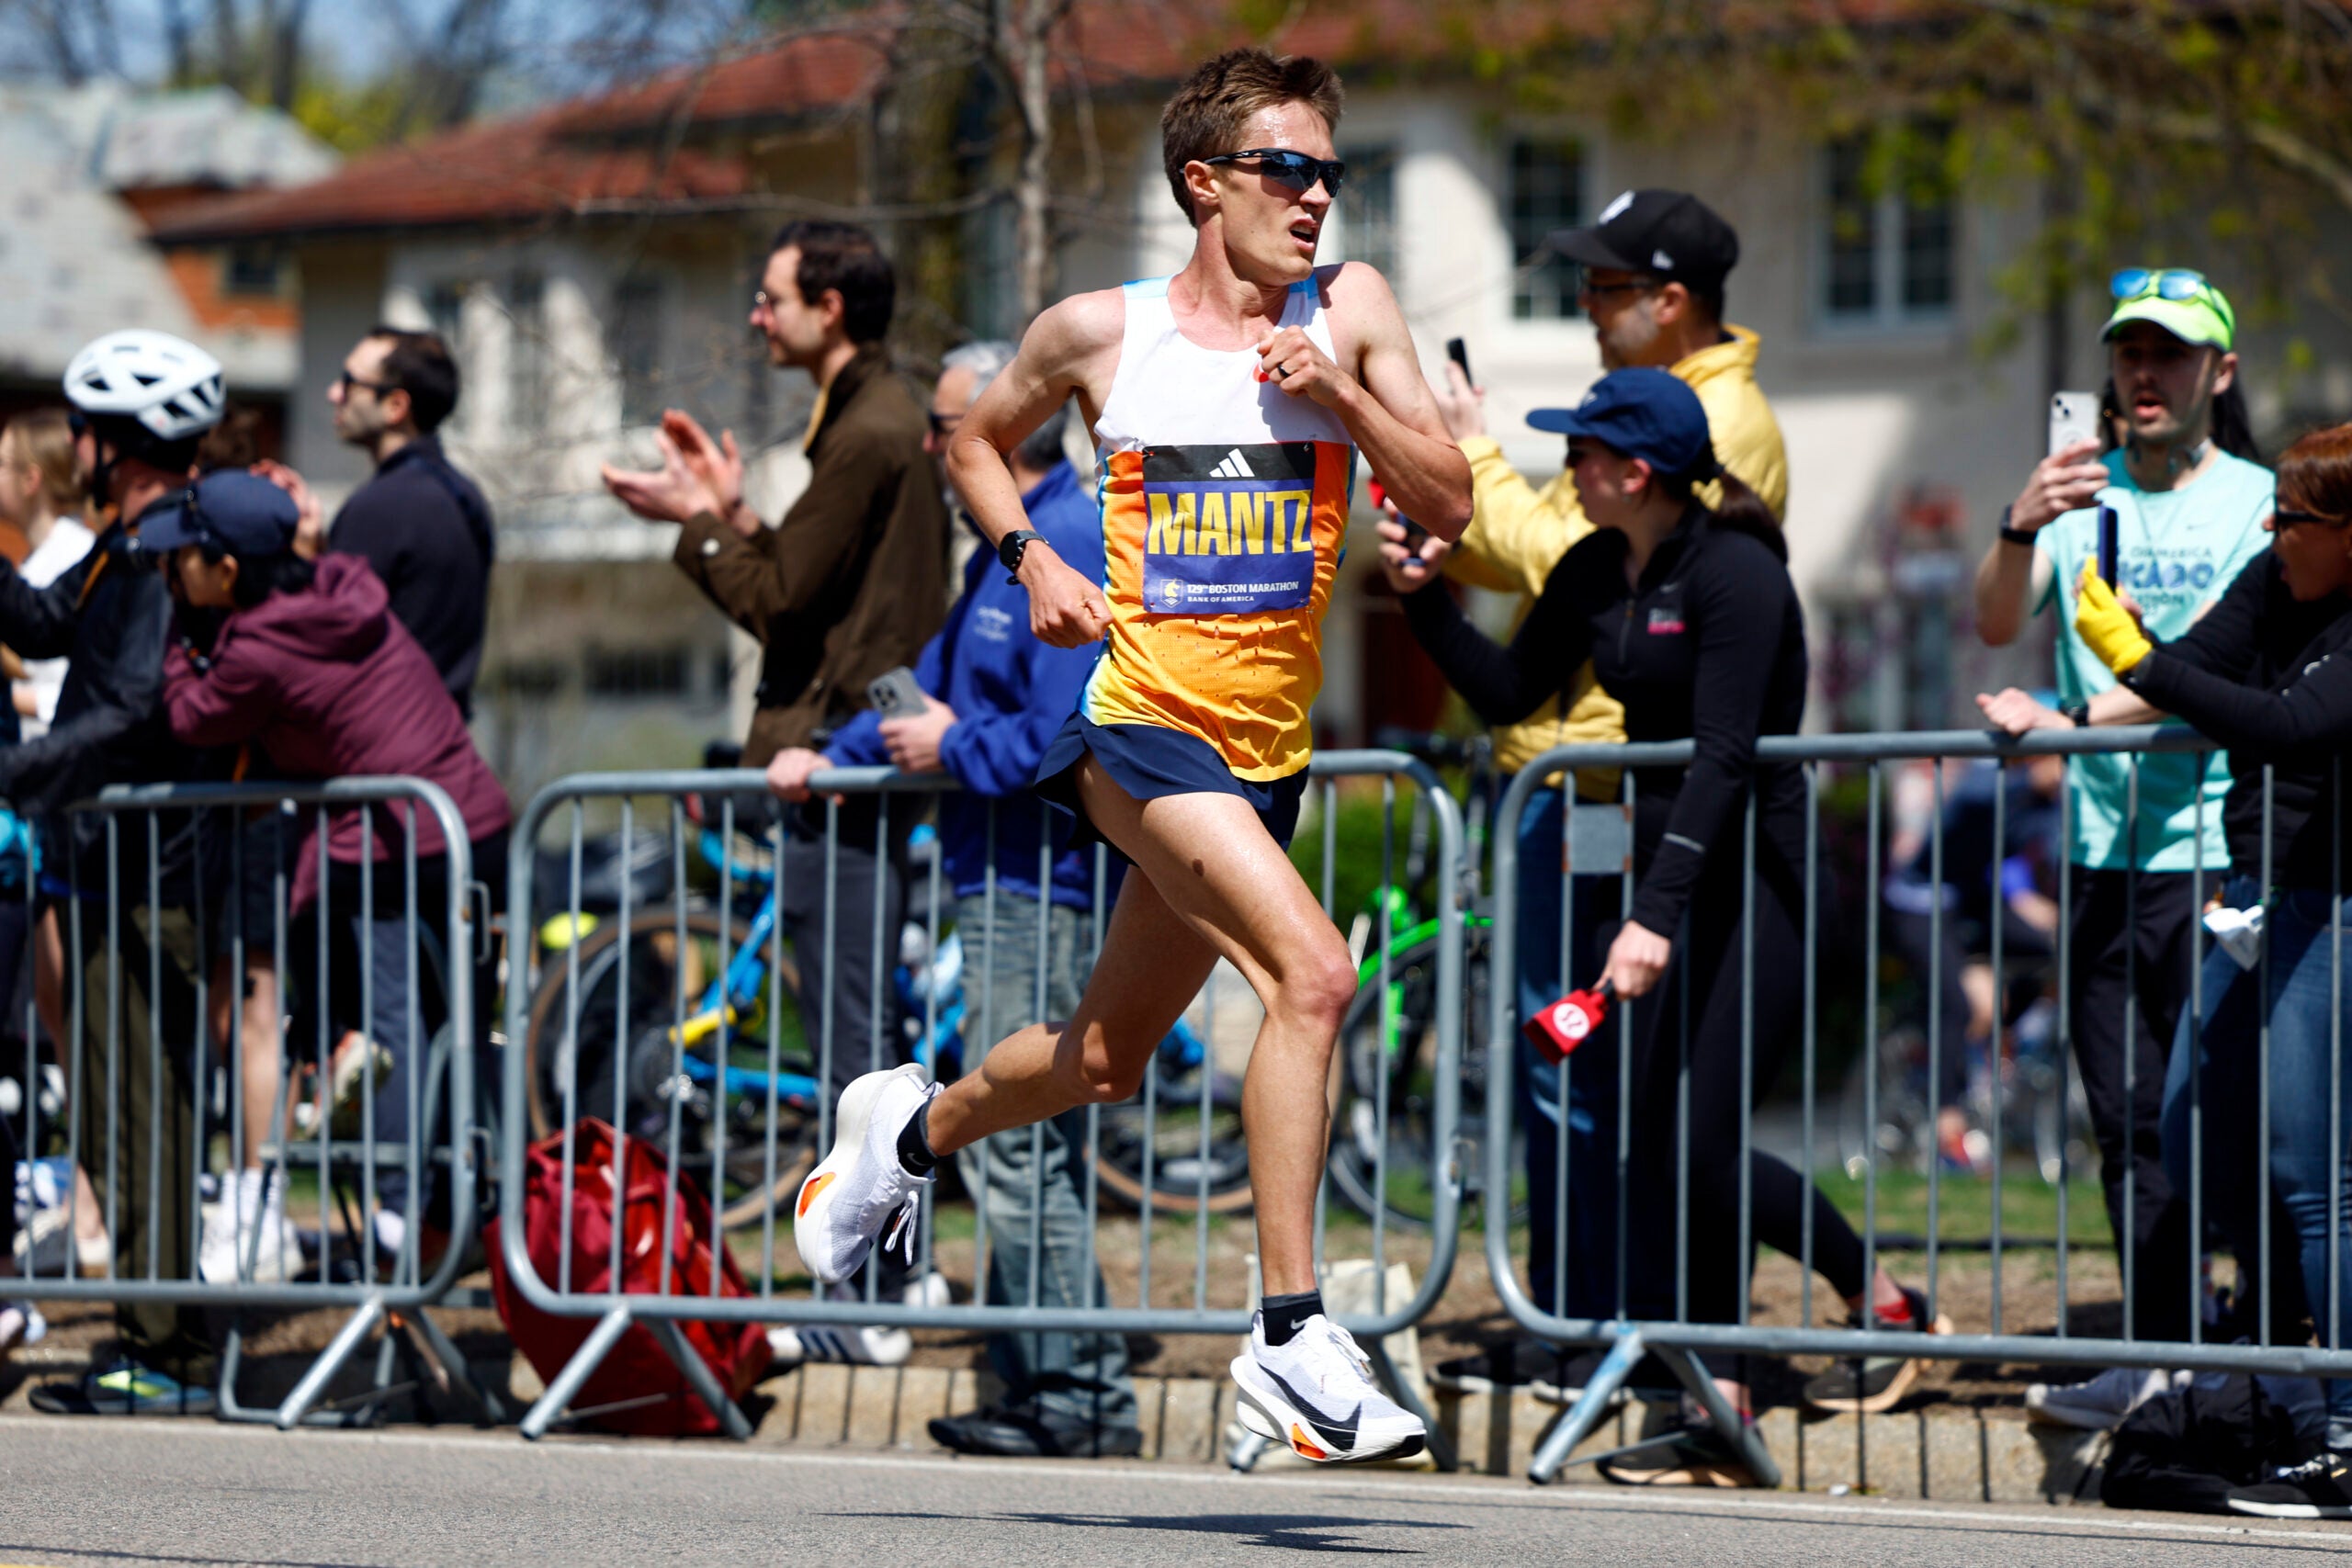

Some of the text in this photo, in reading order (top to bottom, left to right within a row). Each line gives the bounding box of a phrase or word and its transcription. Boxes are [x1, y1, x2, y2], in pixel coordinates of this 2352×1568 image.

[1148, 490, 1312, 555] MANTZ
[1208, 584, 1247, 593] BOSTON
[1249, 581, 1298, 593] MARATHON
